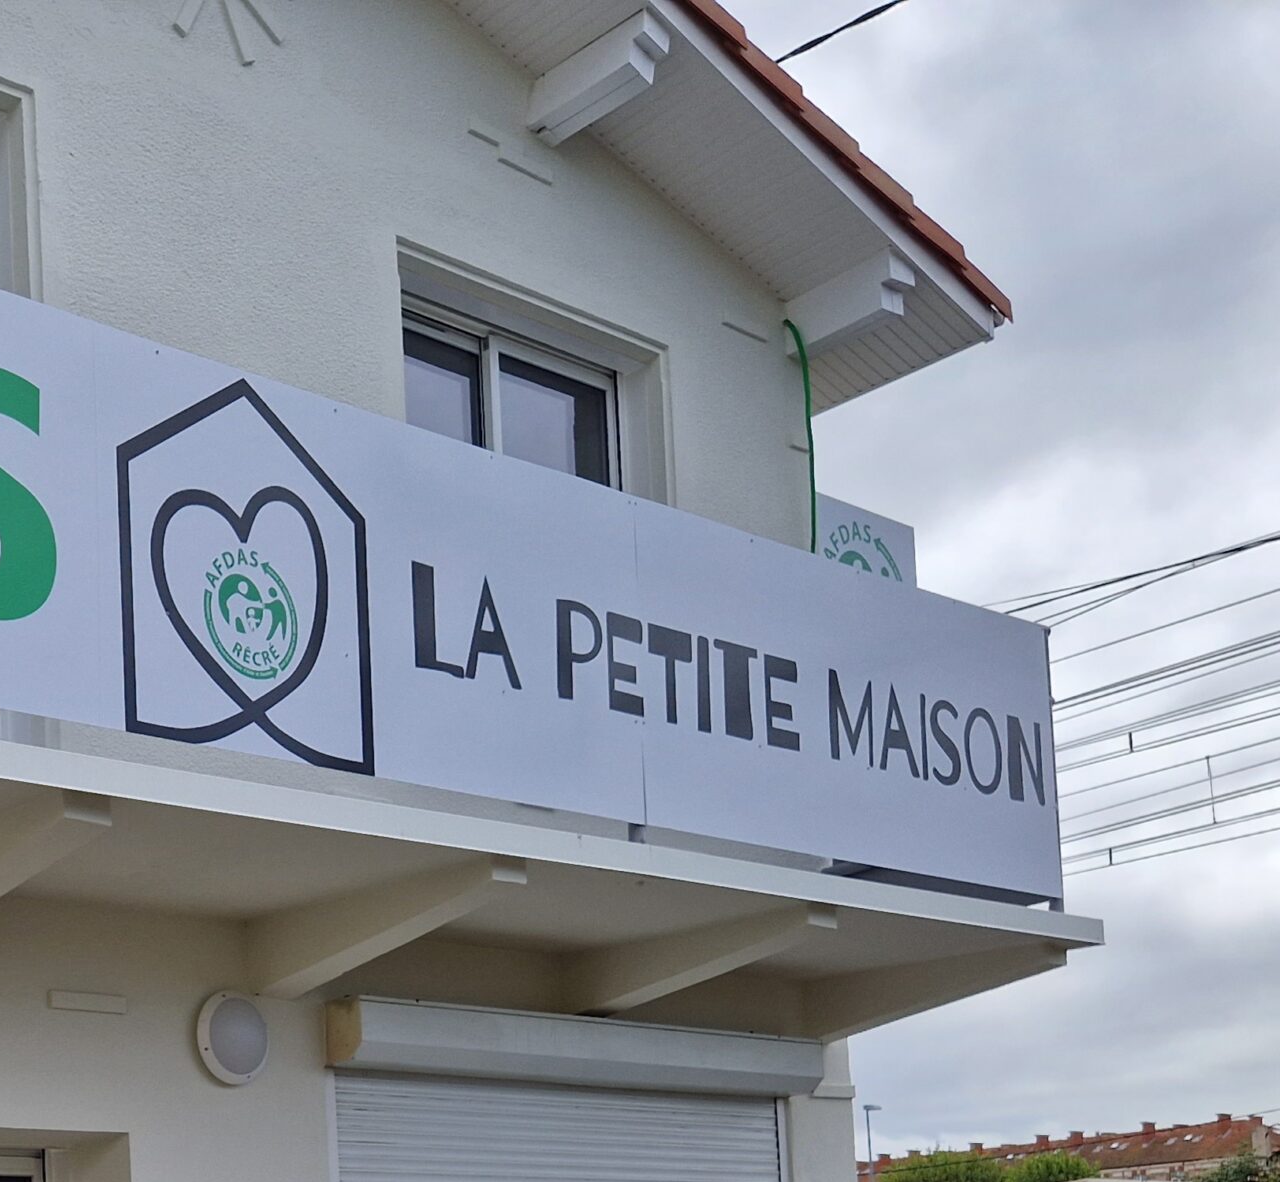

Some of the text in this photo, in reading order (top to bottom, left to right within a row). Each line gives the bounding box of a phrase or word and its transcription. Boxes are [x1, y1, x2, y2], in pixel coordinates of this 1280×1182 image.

[823, 520, 872, 560] AFDAS
[204, 548, 260, 589] AFDAS
[231, 642, 281, 668] RÉCRÉ
[410, 560, 523, 691] LA
[556, 598, 801, 752] PETITE
[828, 668, 1047, 807] MAISON
